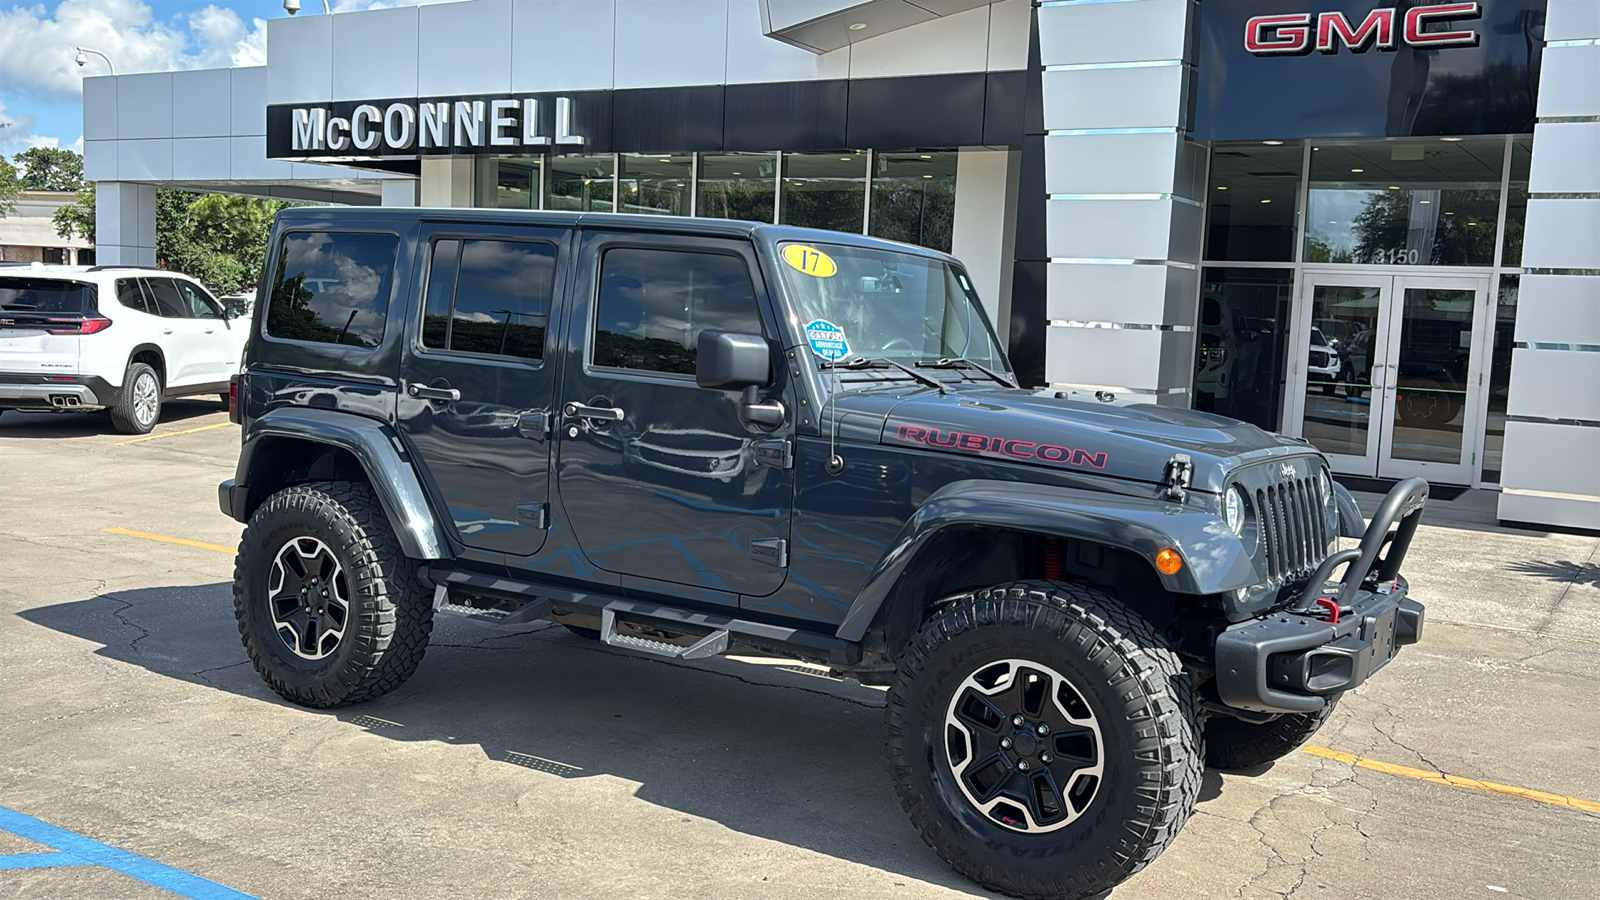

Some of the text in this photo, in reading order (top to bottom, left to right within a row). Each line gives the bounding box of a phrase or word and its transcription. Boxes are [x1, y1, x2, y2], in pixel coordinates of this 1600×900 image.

[1245, 2, 1480, 54] GMC
[292, 97, 584, 150] McCONNELL
[802, 250, 820, 272] 17
[1373, 248, 1419, 264] 3150
[897, 424, 1108, 469] RUBICON
